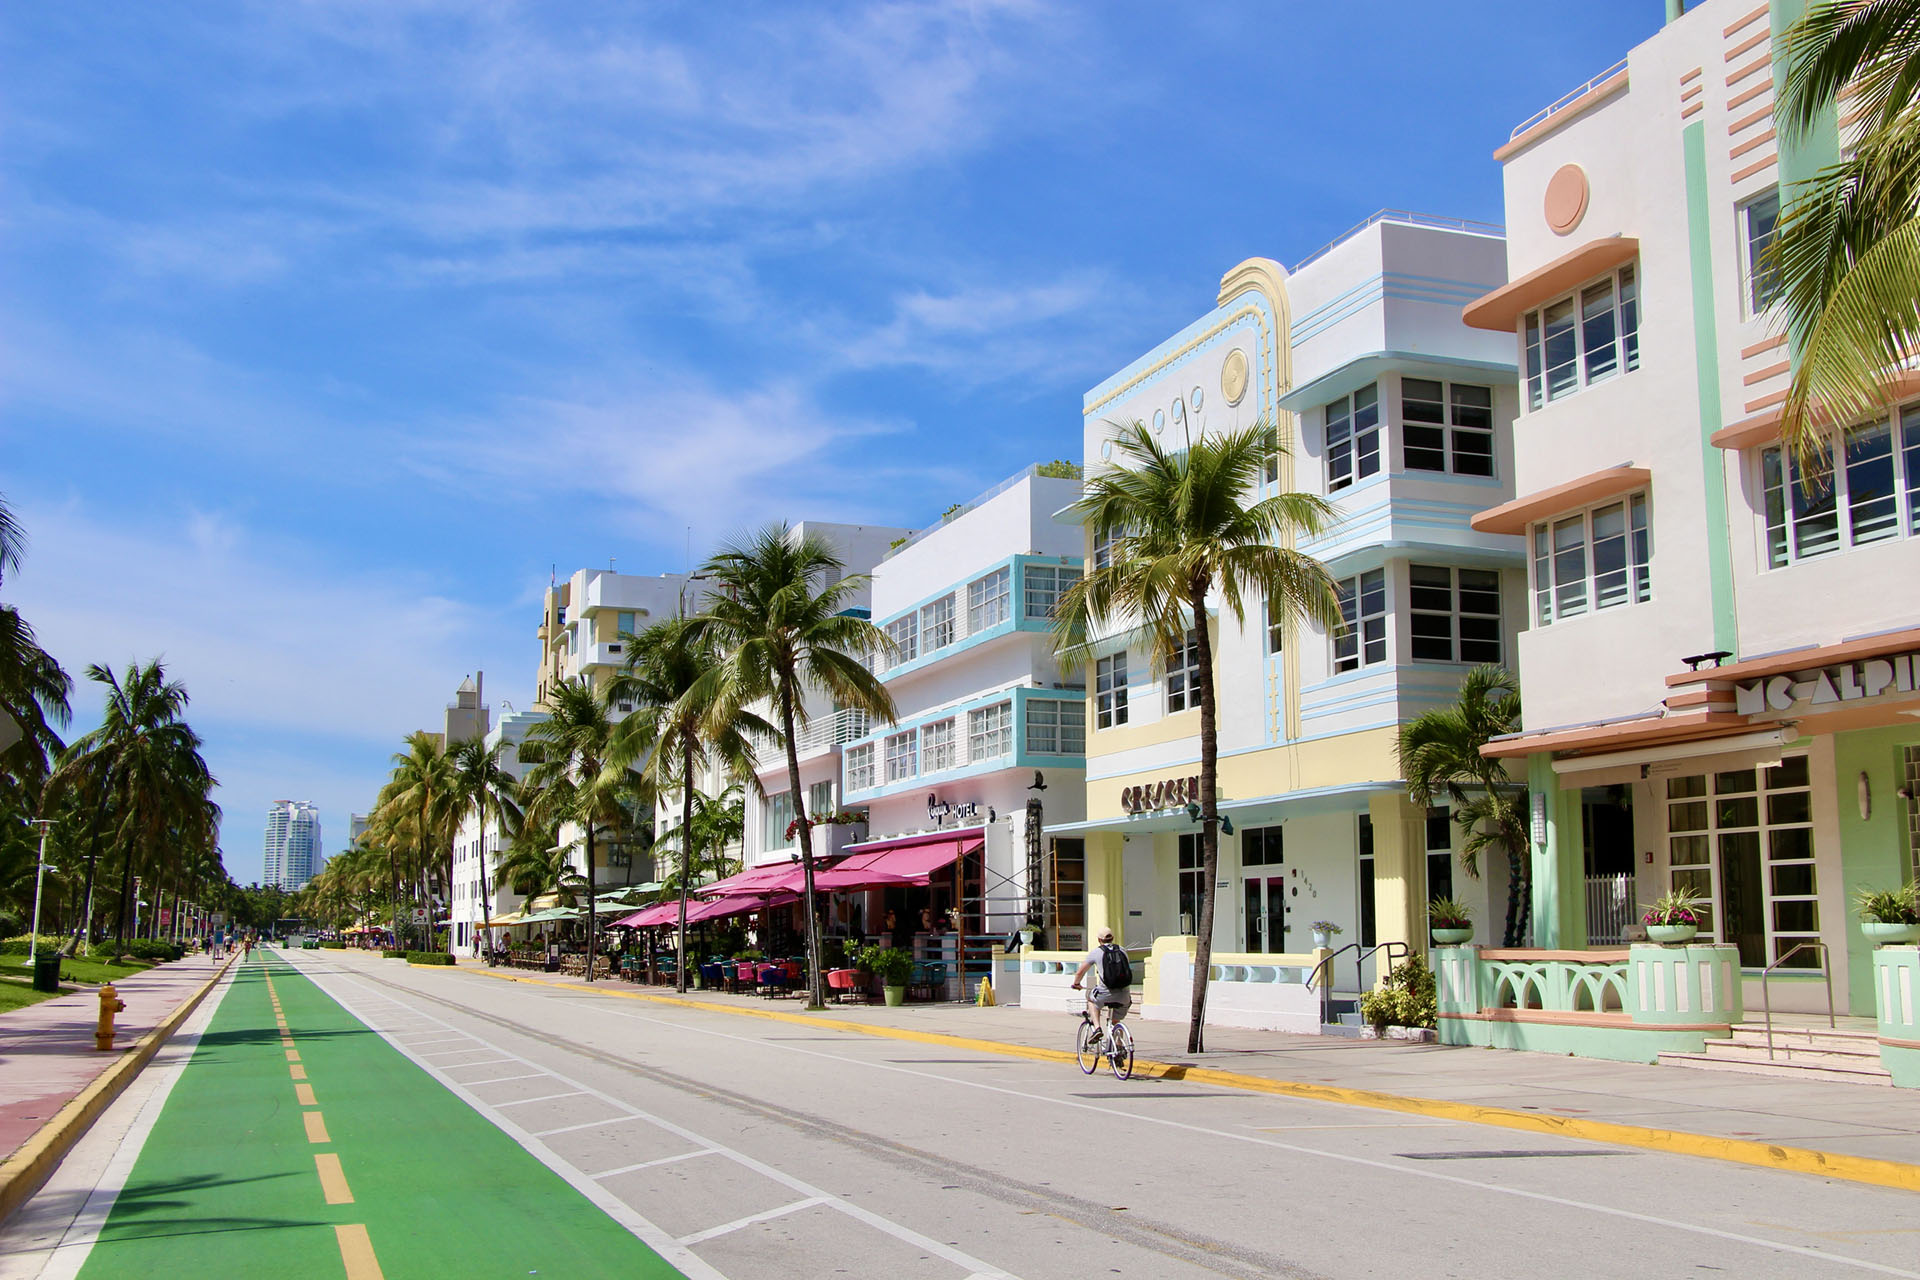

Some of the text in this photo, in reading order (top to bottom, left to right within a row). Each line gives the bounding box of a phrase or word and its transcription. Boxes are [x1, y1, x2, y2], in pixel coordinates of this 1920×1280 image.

[1810, 654, 1920, 705] ALPI
[952, 802, 978, 819] HOTEL
[1121, 775, 1199, 813] CRESCEN
